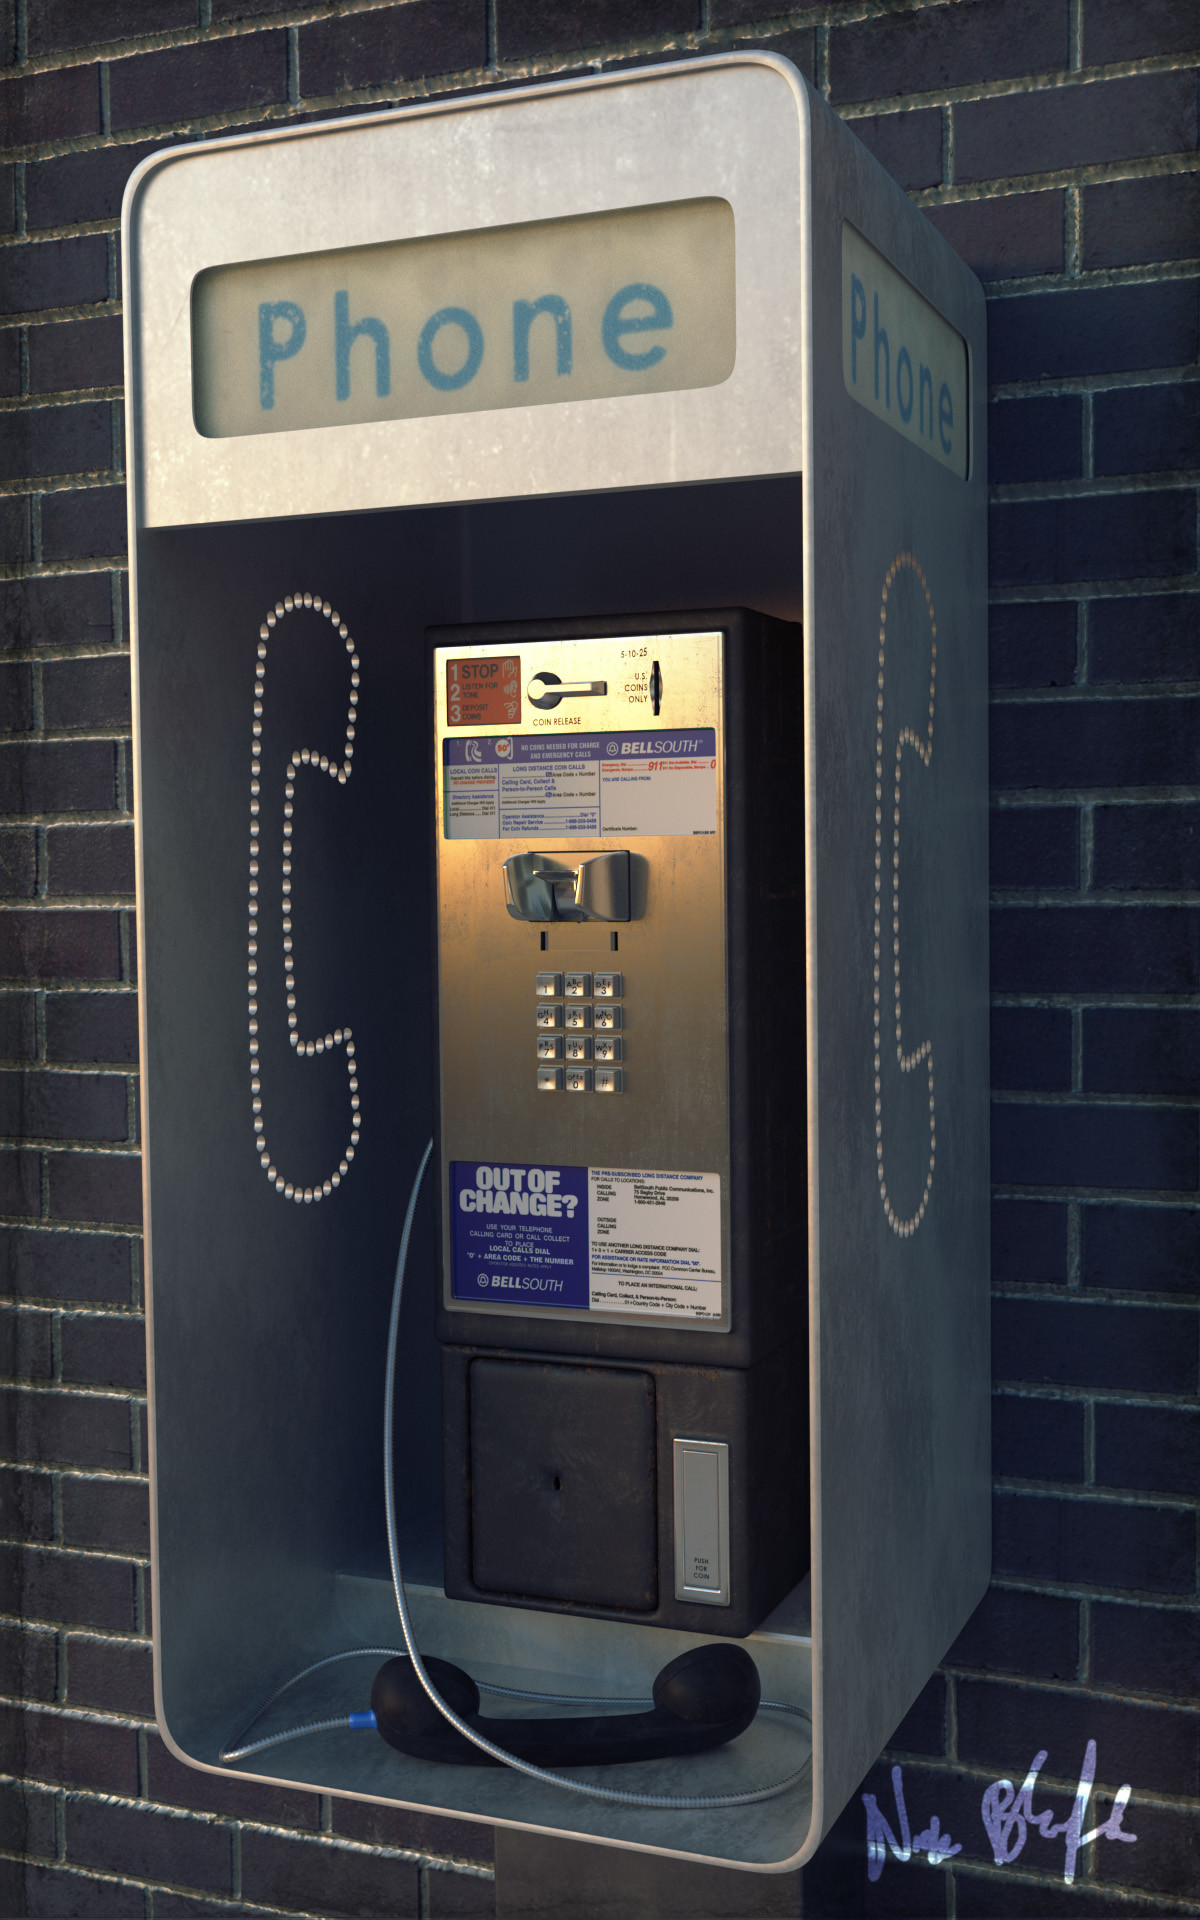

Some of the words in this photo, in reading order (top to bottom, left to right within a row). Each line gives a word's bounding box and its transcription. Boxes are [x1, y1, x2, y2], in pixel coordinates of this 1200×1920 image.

[258, 282, 674, 411] Phone
[850, 271, 954, 456] Phone
[621, 647, 647, 658] 5-10-25
[451, 664, 457, 681] 1
[462, 664, 499, 678] STOP
[450, 684, 460, 701] 2
[450, 705, 460, 722] 3
[621, 740, 698, 754] BELLSOUTH
[476, 1166, 526, 1192] OUT
[528, 1168, 560, 1193] OF
[460, 1189, 578, 1218] CHANGE?
[492, 1276, 563, 1291] BELLSOUTH
